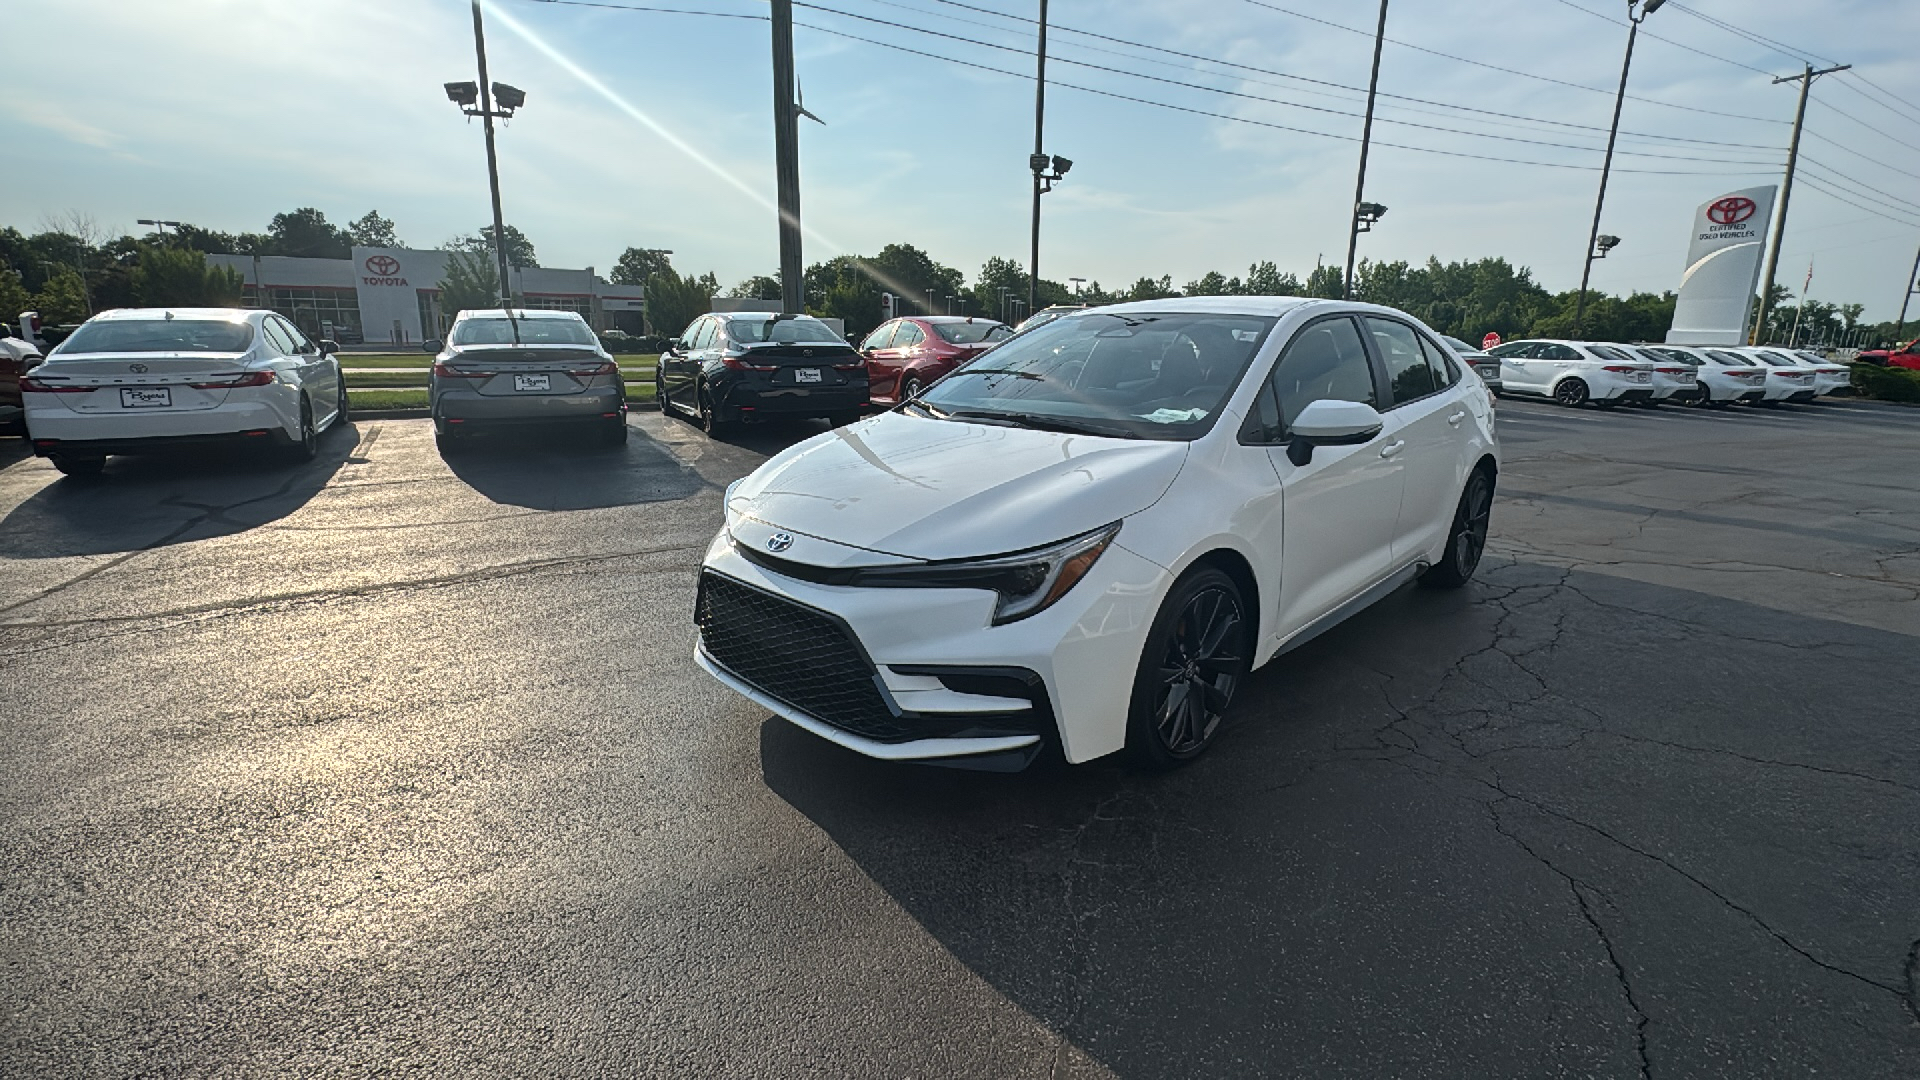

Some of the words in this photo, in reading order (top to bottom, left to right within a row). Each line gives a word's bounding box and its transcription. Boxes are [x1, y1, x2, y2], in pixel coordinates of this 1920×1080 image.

[1709, 223, 1747, 232] CERTIFIED
[1699, 233, 1718, 241] USED
[1719, 230, 1755, 239] VEHICLES
[362, 276, 409, 287] TOYOTA
[1483, 338, 1500, 349] STOP
